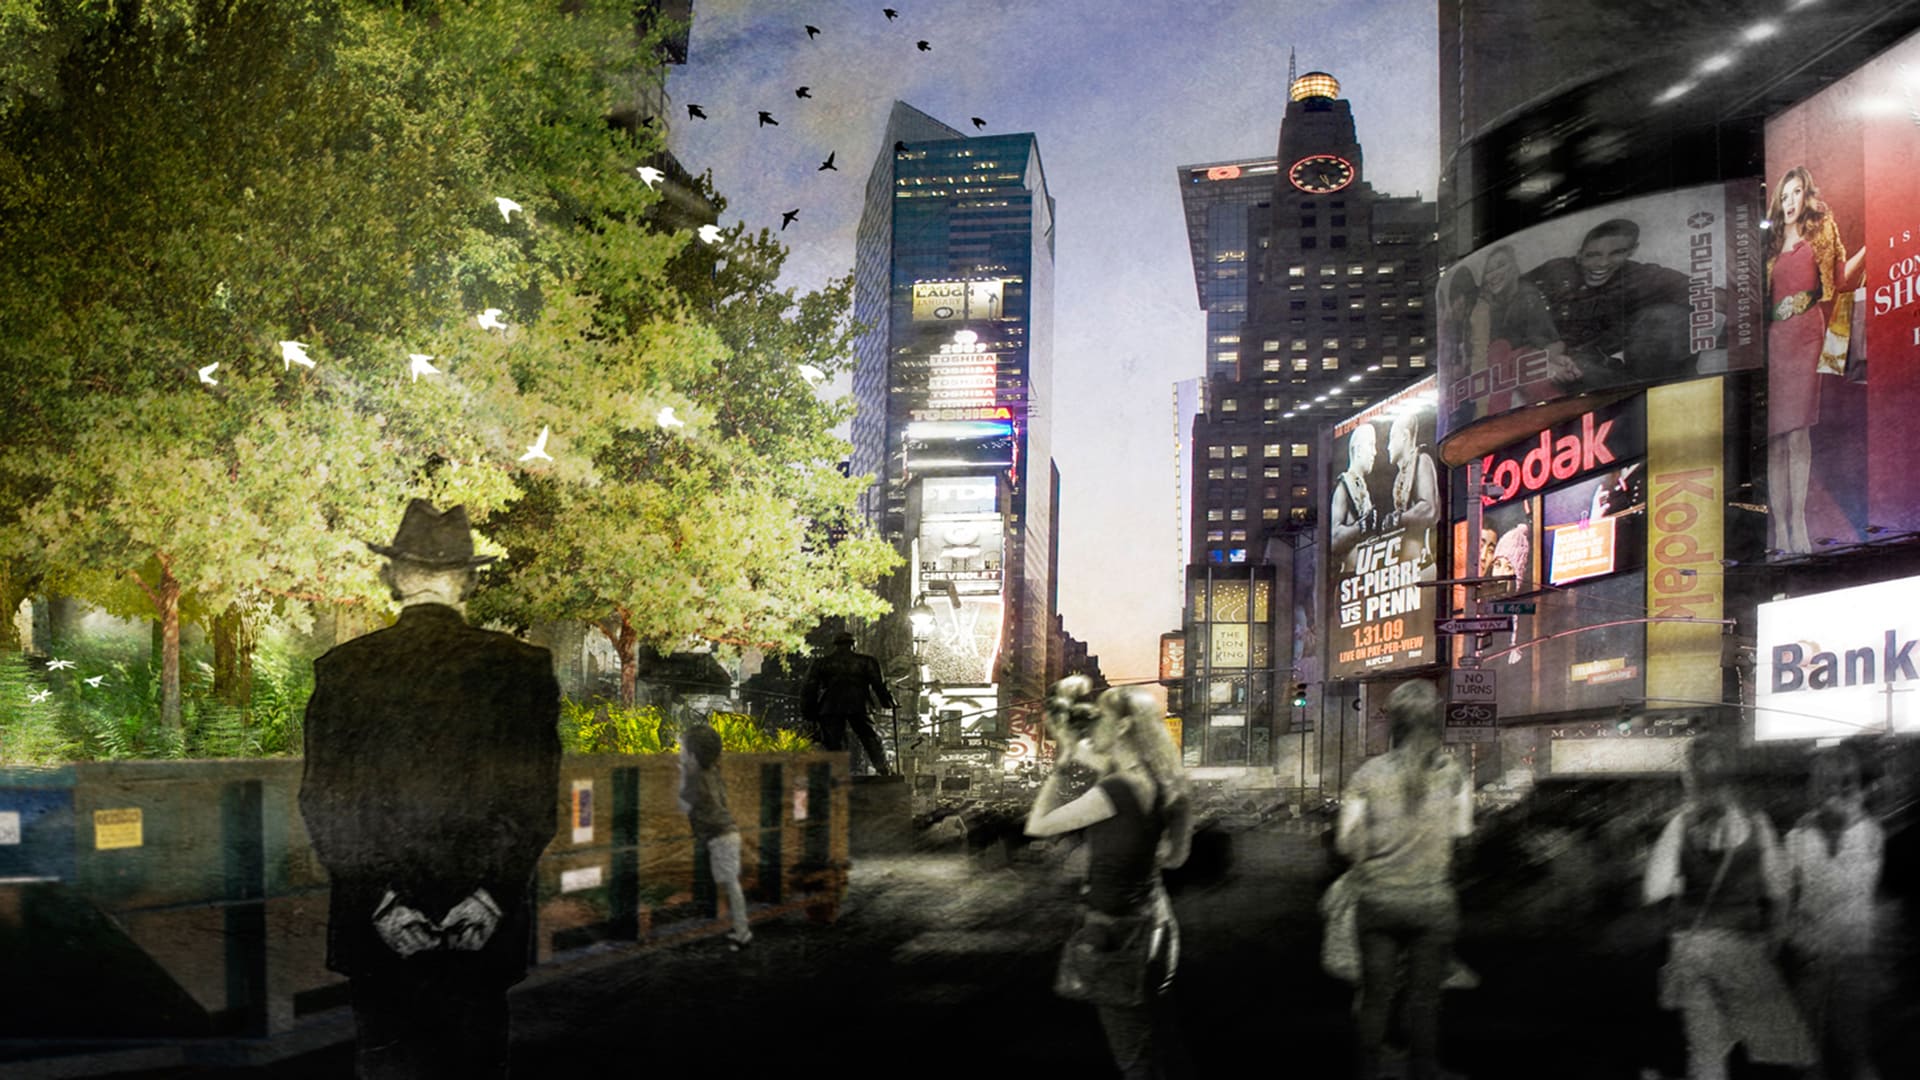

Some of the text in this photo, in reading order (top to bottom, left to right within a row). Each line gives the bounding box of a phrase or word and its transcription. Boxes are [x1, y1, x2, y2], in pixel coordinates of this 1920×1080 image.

[915, 289, 975, 298] LAUGH
[1690, 232, 1715, 354] SOUTHPOLE
[931, 354, 994, 364] TOSHIBA
[931, 366, 995, 375] TOSHIBA
[931, 389, 994, 398] TOSHIBA
[910, 407, 1011, 420] TOSHIBA
[1653, 467, 1715, 625] Kodak
[1356, 536, 1403, 575] UFC
[922, 572, 998, 580] CHEVROLET
[1340, 557, 1422, 603] ST-PIERRE
[1340, 586, 1421, 623] VS PENN
[1508, 604, 1521, 614] 46
[1479, 620, 1504, 629] WAY
[1220, 631, 1240, 639] THE
[1353, 618, 1404, 648] 1.31.09
[1216, 640, 1244, 650] LION
[1340, 650, 1355, 663] LIVE
[1355, 647, 1366, 660] ON
[1367, 636, 1424, 658] PAY-PER-VIEW
[1215, 651, 1244, 662] KING
[1772, 629, 1920, 694] Bank
[1465, 673, 1484, 684] NO
[1456, 684, 1493, 695] TURNS
[1551, 728, 1697, 738] MARQUIS
